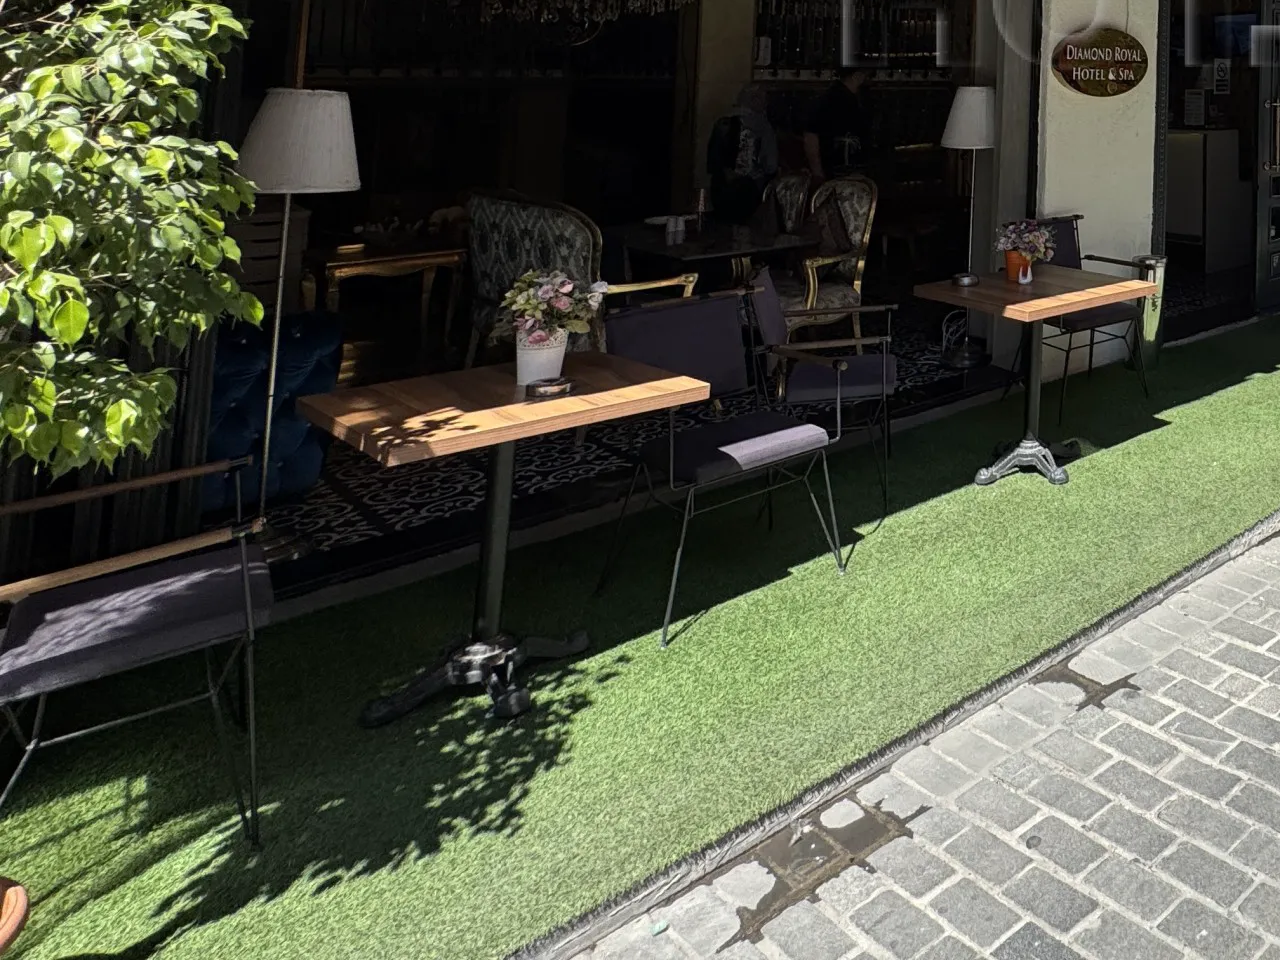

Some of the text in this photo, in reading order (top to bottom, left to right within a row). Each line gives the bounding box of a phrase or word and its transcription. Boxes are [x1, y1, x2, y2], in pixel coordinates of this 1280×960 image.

[1066, 44, 1142, 62] DIAMOND ROYAL
[1072, 66, 1106, 81] HOTEL
[1118, 67, 1135, 81] SPA
